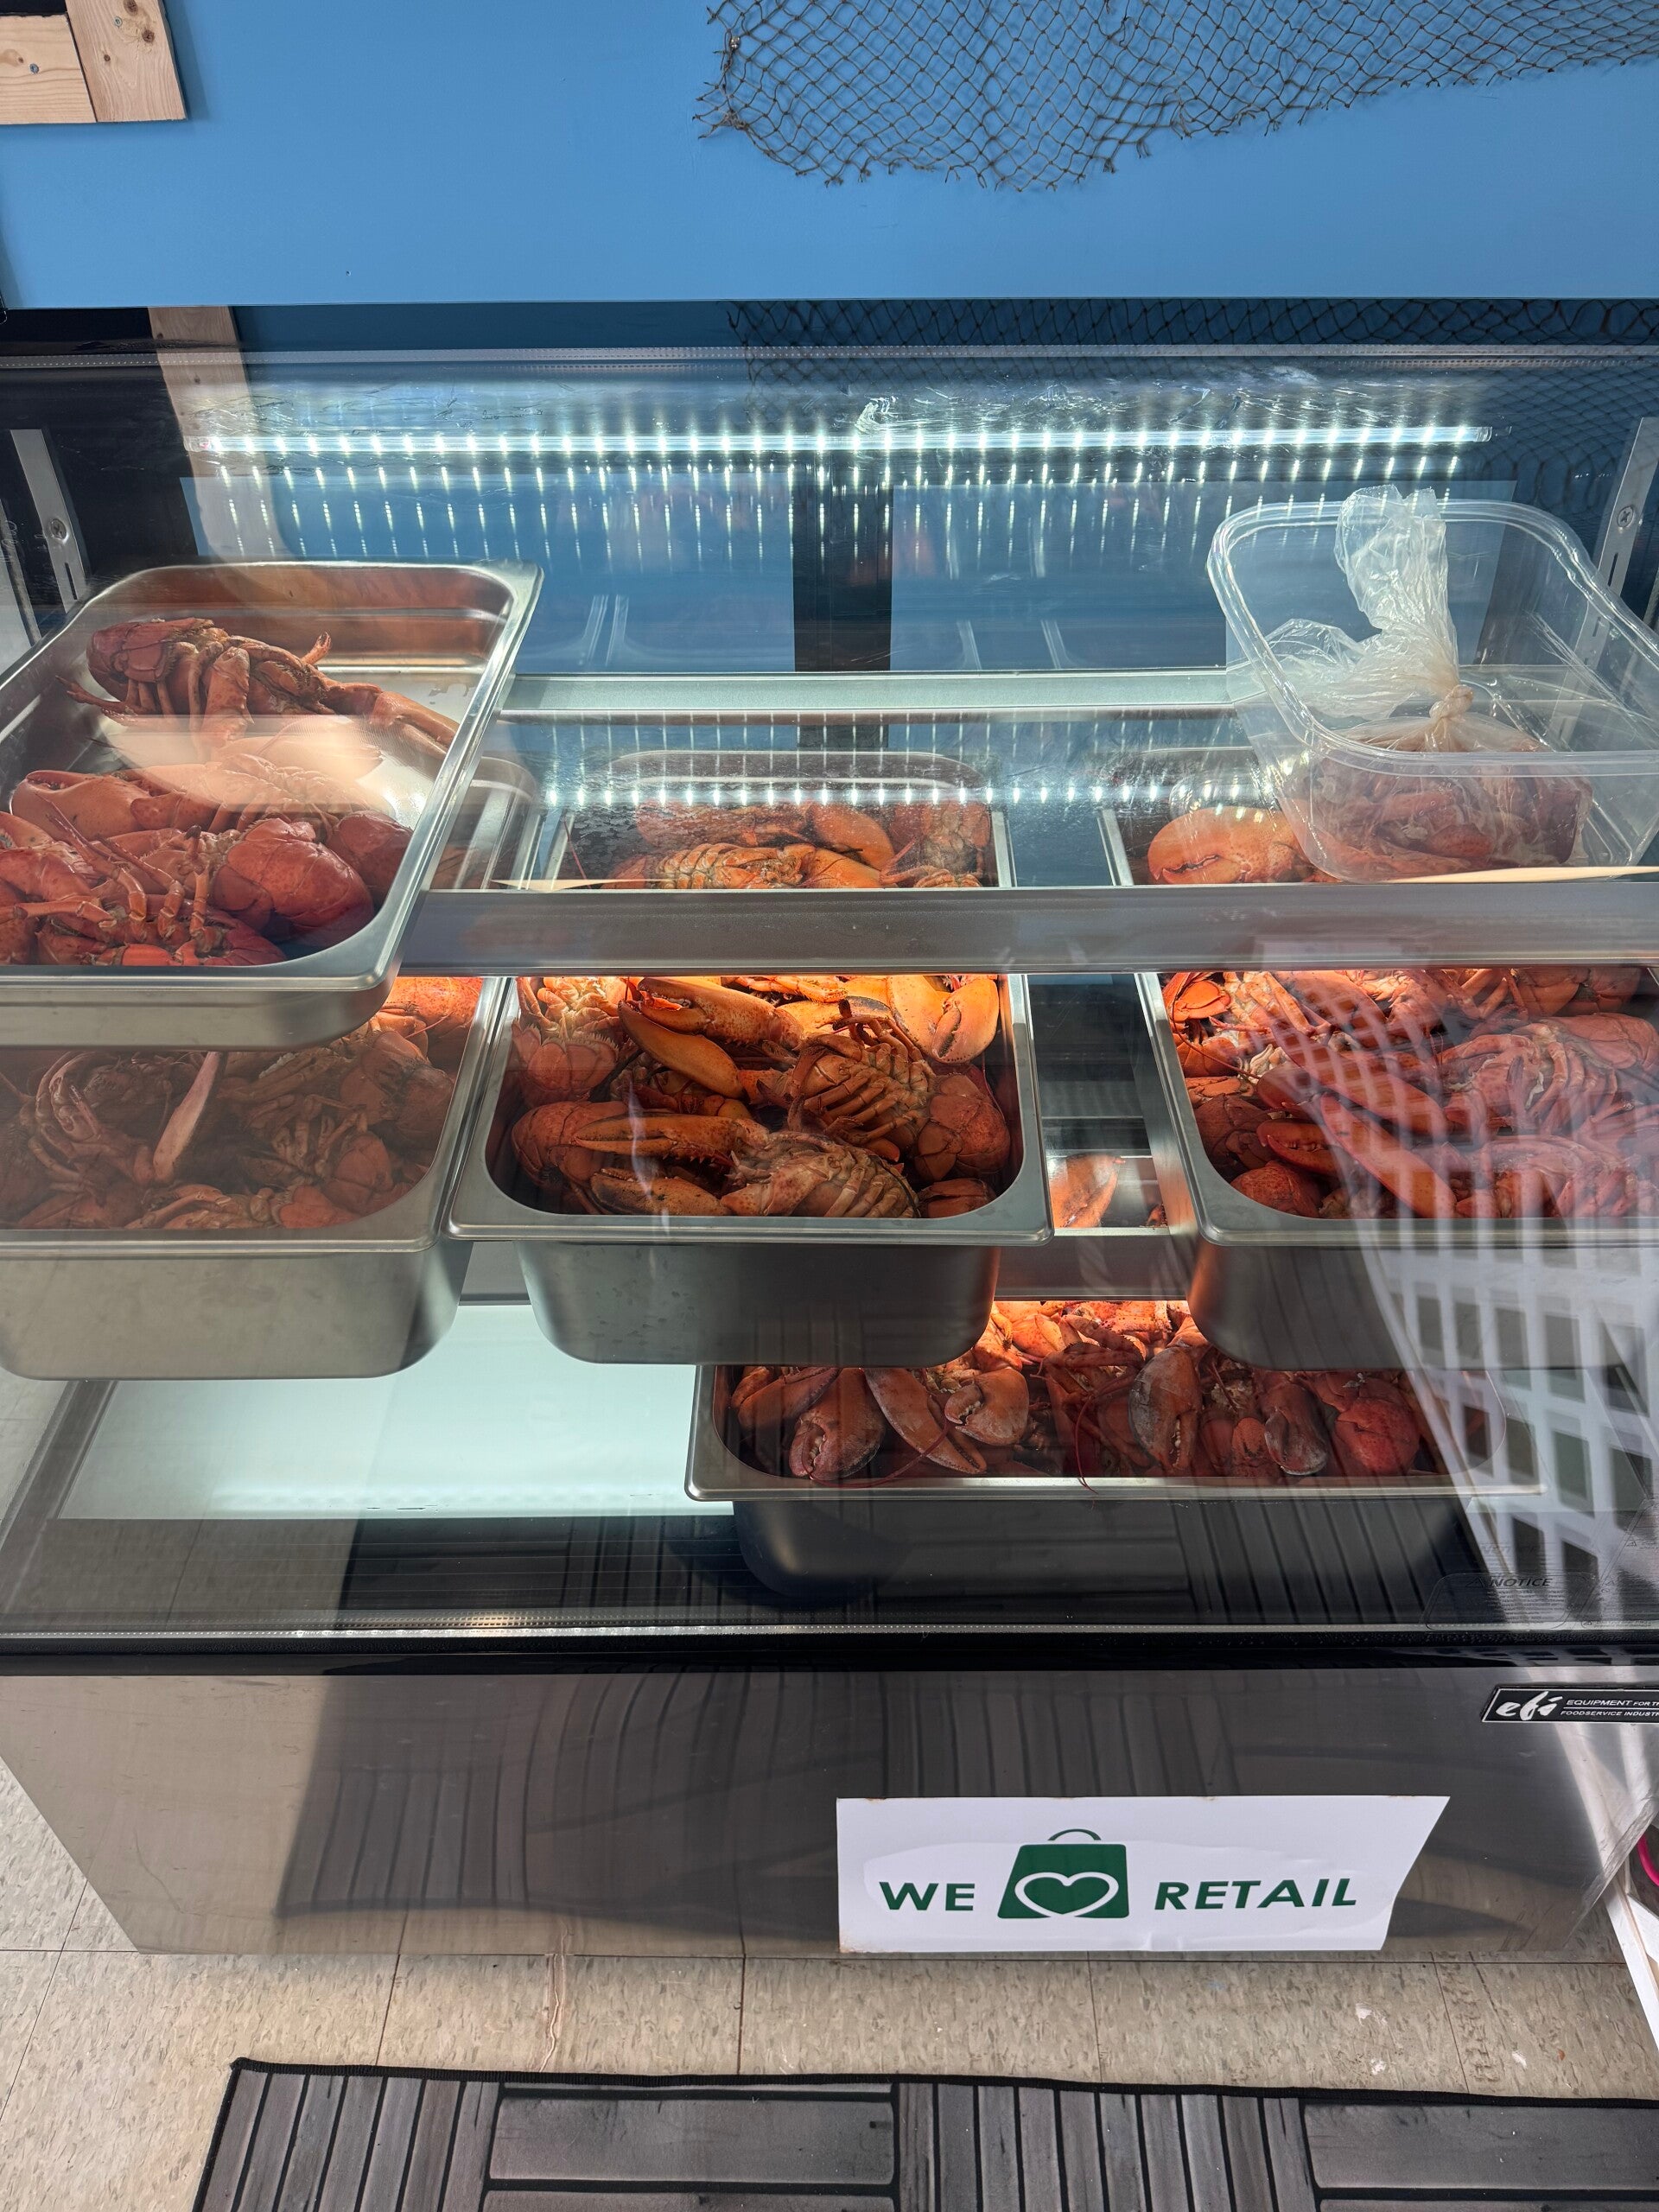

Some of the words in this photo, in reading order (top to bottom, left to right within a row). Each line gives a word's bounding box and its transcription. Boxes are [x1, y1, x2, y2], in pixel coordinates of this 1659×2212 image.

[1490, 1578, 1553, 1586] NOTICE
[880, 1883, 974, 1910] WE
[1156, 1879, 1355, 1910] RETAIL
